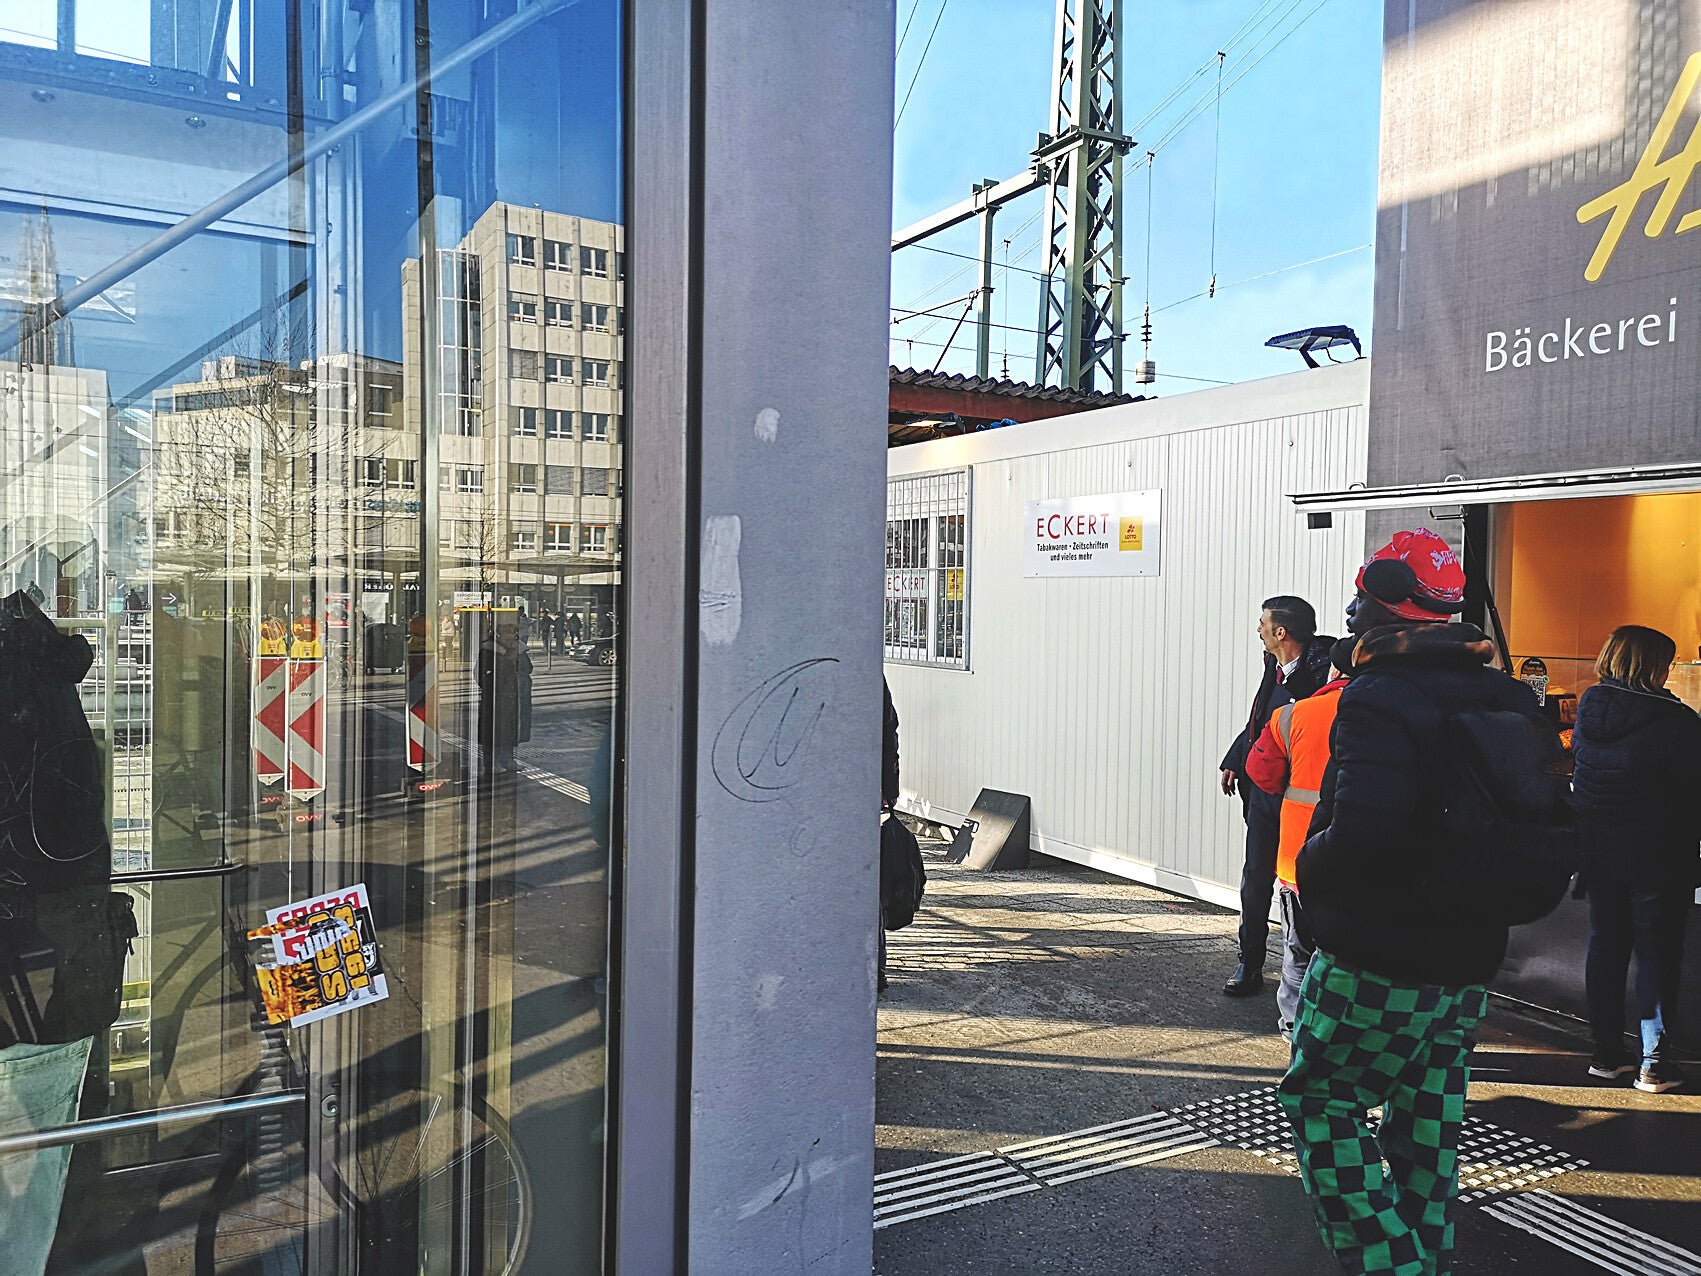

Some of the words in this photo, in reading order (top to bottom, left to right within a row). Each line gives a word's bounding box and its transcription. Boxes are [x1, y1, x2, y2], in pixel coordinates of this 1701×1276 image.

[1484, 297, 1678, 374] Bäckerei
[1036, 512, 1110, 540] ECKERT
[1037, 542, 1068, 552] Tabakwaren
[1072, 540, 1109, 551] Zeitschriften
[1050, 553, 1060, 561] und
[1061, 553, 1077, 561] vieles
[1078, 552, 1093, 561] mehr
